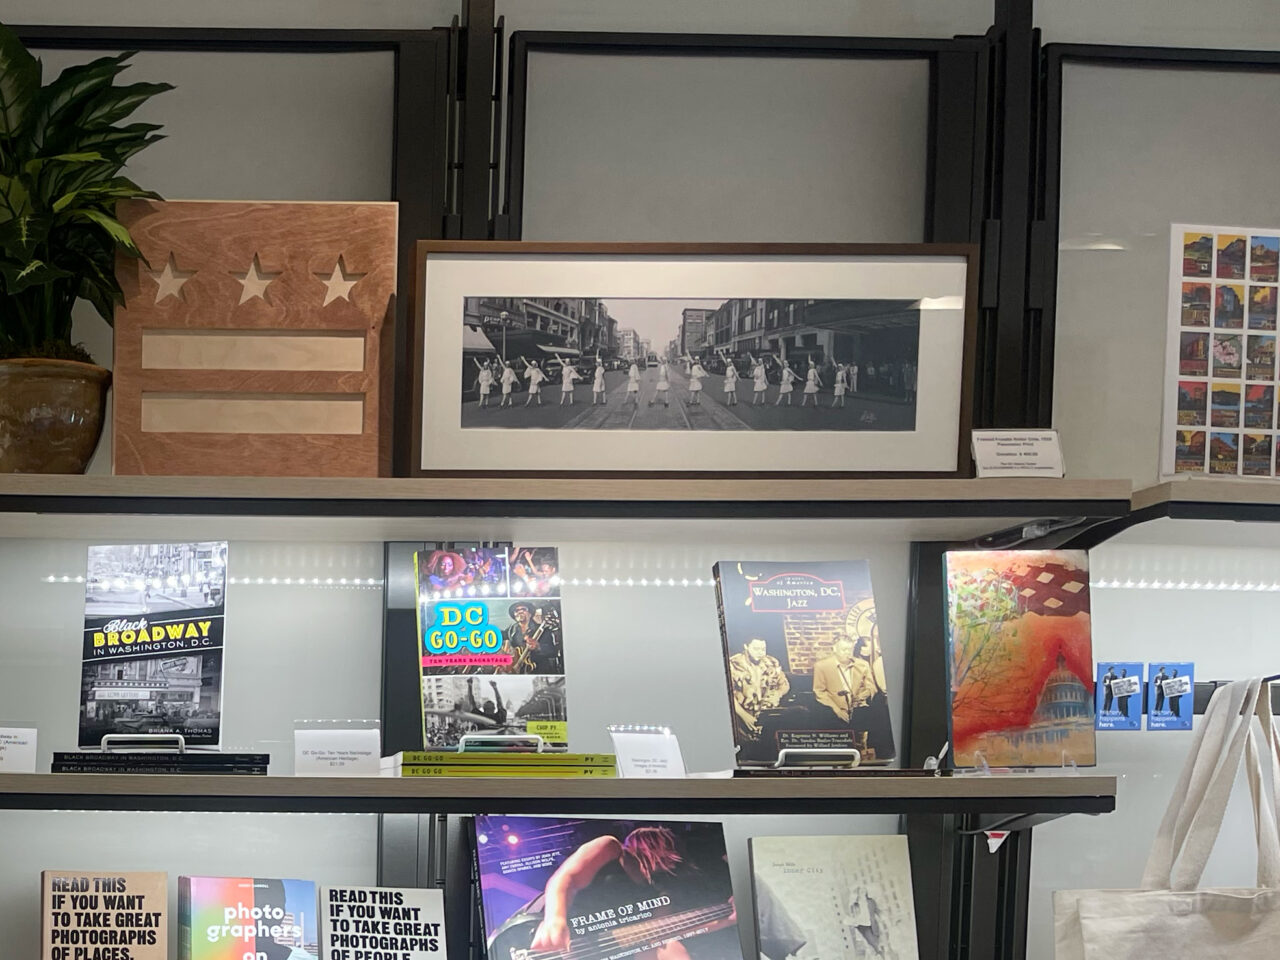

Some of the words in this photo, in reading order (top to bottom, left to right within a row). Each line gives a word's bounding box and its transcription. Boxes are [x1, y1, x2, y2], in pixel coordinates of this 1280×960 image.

[753, 587, 818, 597] WASHINGTON,
[820, 587, 841, 597] DC,
[787, 598, 808, 608] JAZZ
[103, 617, 148, 633] Black
[440, 607, 483, 626] DC
[93, 621, 211, 647] BROADWAY
[430, 630, 497, 648] GO-GO
[93, 648, 104, 656] IN
[108, 641, 188, 654] WASHINGTON,
[191, 638, 213, 646] D.C.
[52, 877, 89, 892] READ
[93, 877, 126, 892] THIS
[52, 895, 65, 910] IF
[70, 895, 98, 910] YOU
[103, 895, 144, 910] WANT
[329, 889, 367, 903] READ
[369, 891, 404, 905] THIS
[52, 912, 70, 927] TO
[75, 912, 111, 927] TAKE
[115, 912, 161, 927] GREAT
[224, 902, 284, 924] photo
[330, 904, 344, 917] IF
[347, 905, 375, 918] YOU
[379, 907, 421, 921] WANT
[571, 908, 616, 927] FRAME
[618, 904, 636, 916] OF
[638, 896, 671, 911] MIND
[207, 920, 302, 942] graphers
[330, 919, 349, 932] TO
[353, 920, 390, 934] TAKE
[394, 922, 440, 936] GREAT
[575, 927, 586, 935] by
[588, 920, 618, 932] antonia
[619, 912, 652, 924] tricarico
[51, 929, 156, 945] PHOTOGRAPHS
[331, 934, 439, 951] PHOTOGRAPHS
